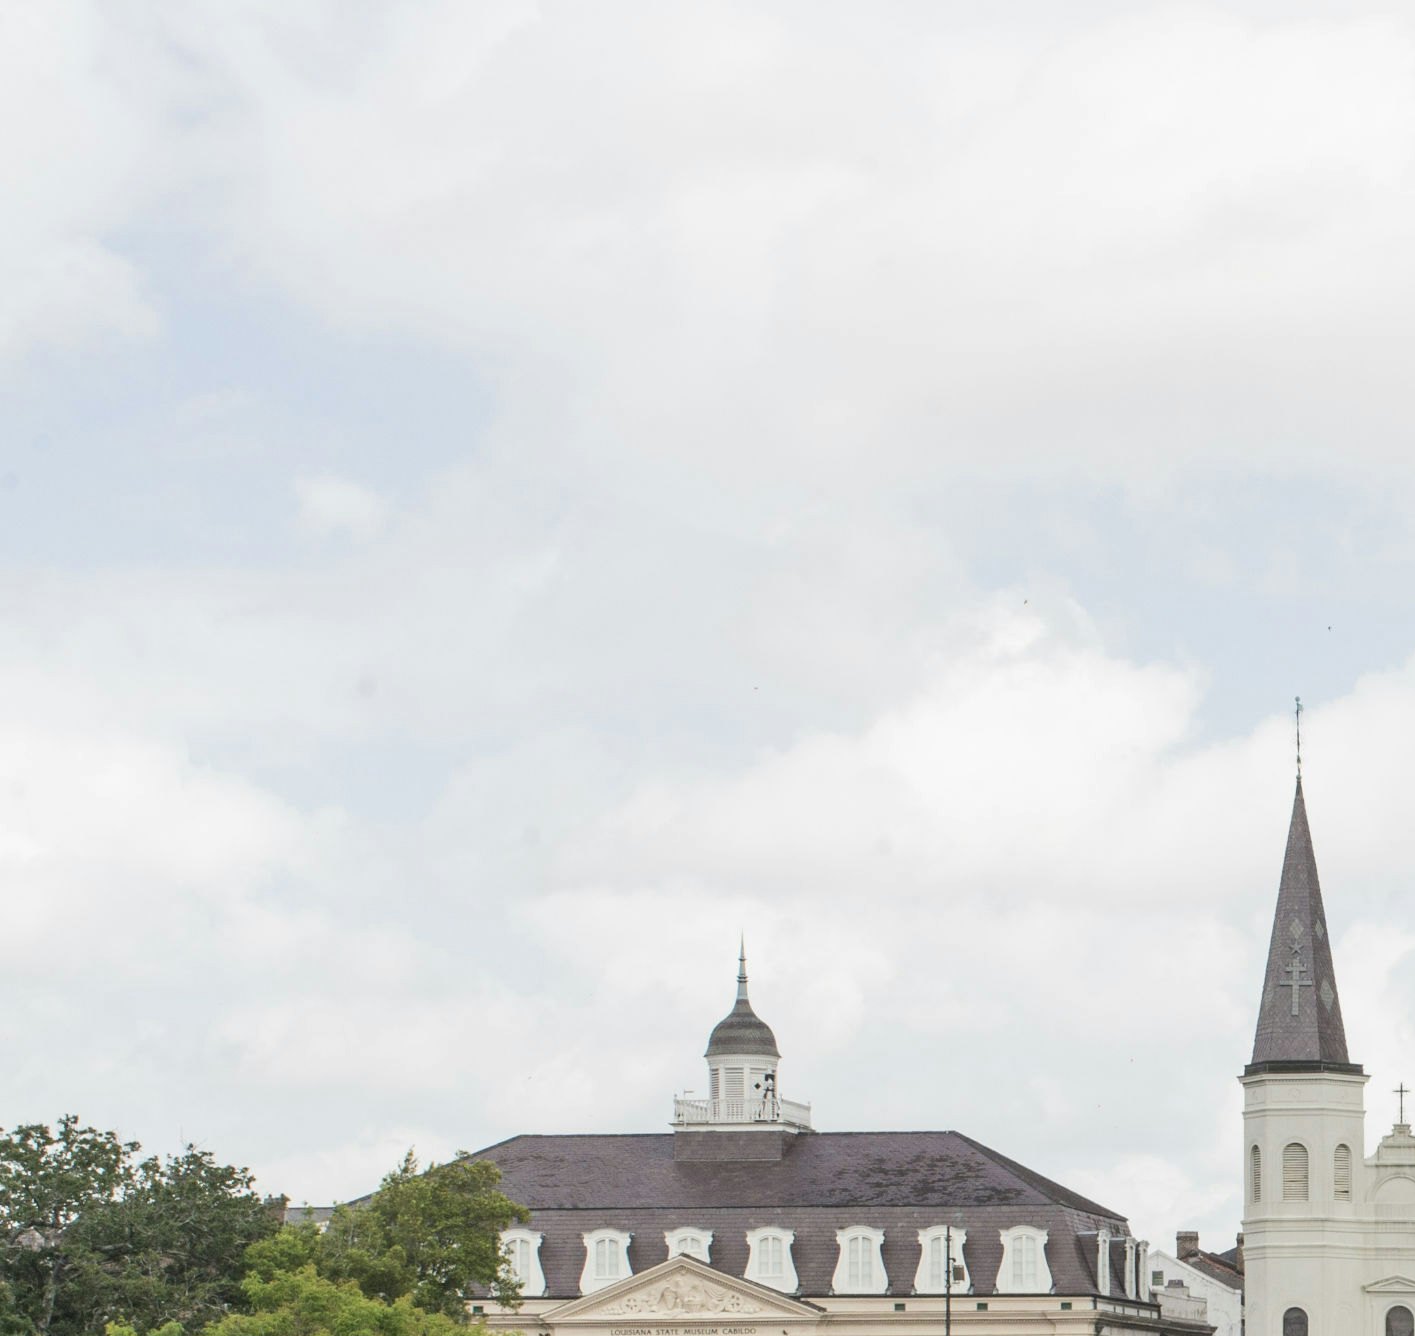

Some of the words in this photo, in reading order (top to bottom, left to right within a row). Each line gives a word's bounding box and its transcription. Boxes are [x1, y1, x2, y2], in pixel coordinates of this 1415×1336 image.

[610, 1328, 652, 1336] LOUISIANA
[655, 1328, 679, 1336] STATE
[683, 1328, 719, 1336] MUSEUM
[722, 1327, 757, 1335] CABILDO
